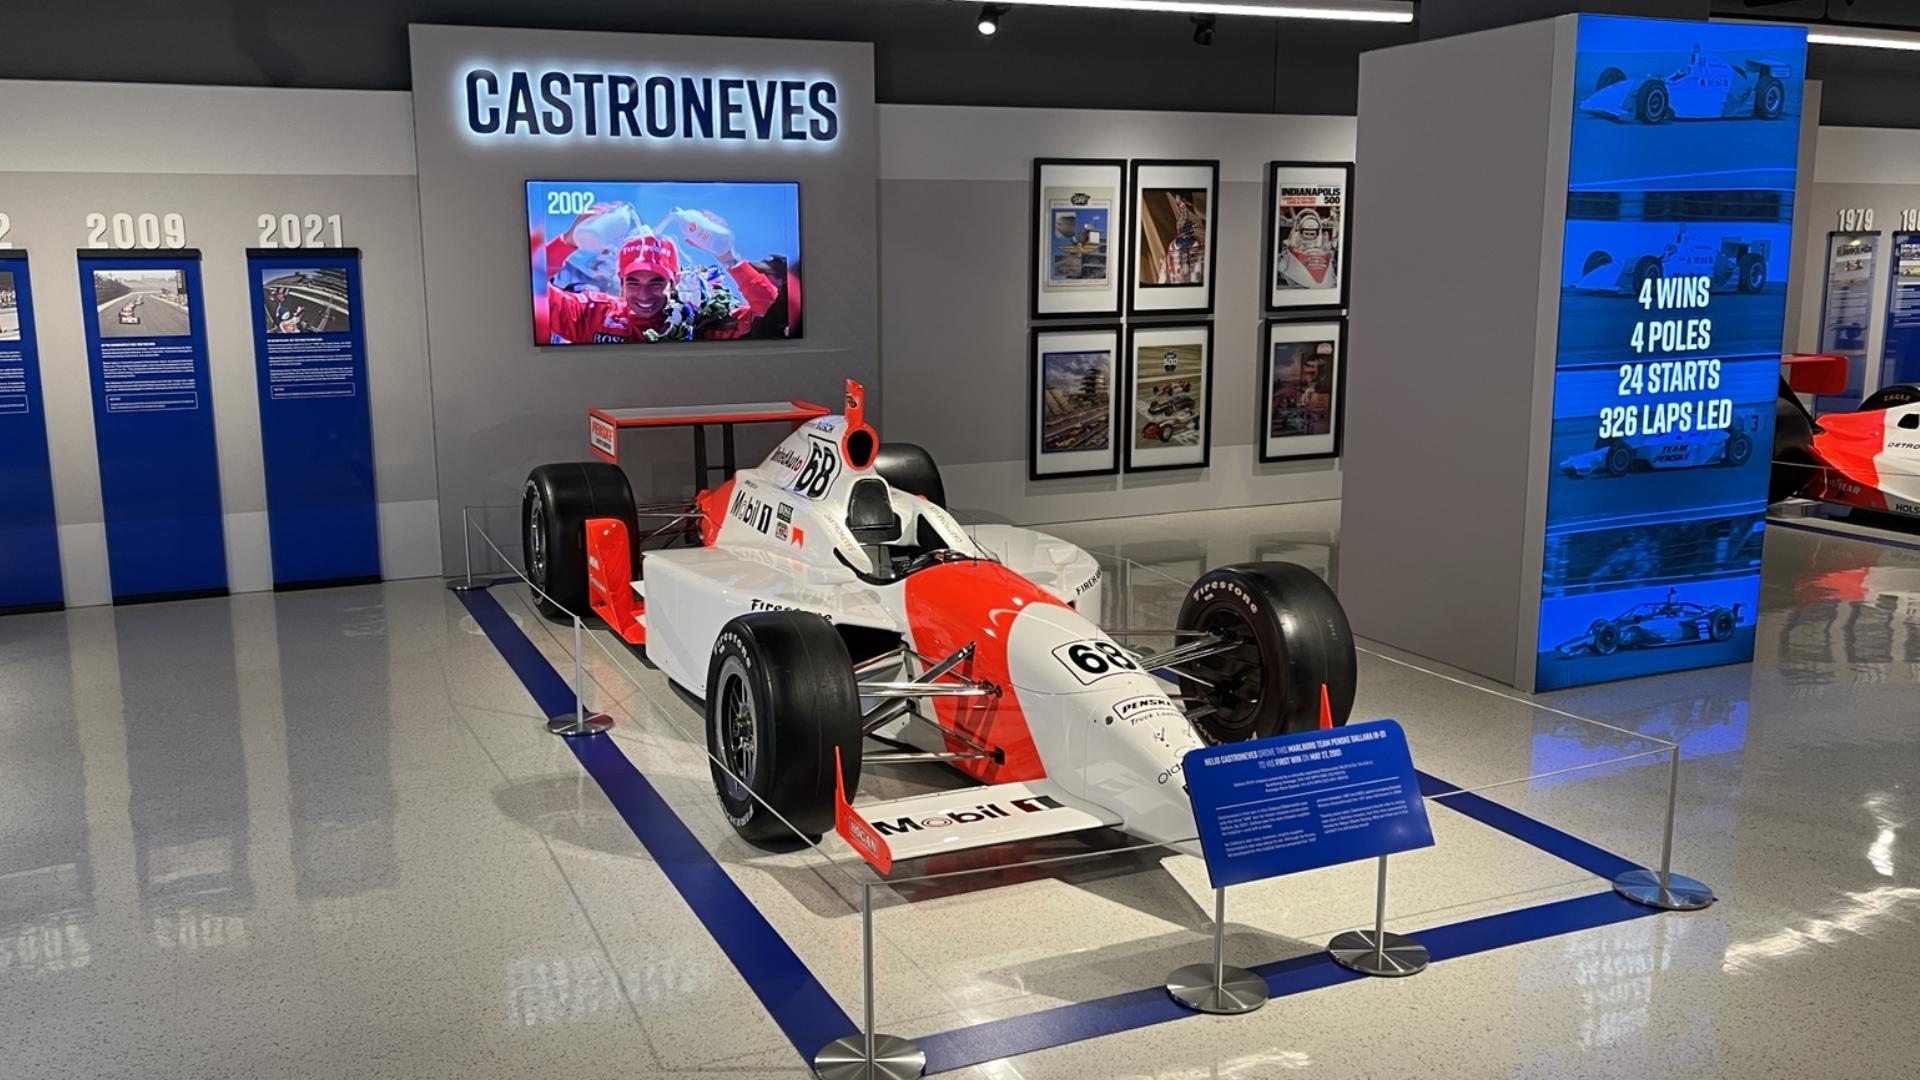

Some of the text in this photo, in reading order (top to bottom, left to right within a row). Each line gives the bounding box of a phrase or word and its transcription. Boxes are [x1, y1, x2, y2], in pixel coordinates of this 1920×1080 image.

[466, 69, 838, 142] CASTRONEVES
[547, 191, 595, 214] 2002
[1281, 187, 1340, 196] INDIANAPOLIS
[1324, 196, 1340, 204] 500
[86, 212, 186, 250] 2009
[257, 213, 344, 249] 2021
[1838, 208, 1874, 232] 1979
[1638, 276, 1711, 310] 4 WINS
[1630, 318, 1712, 353] 4 POLES
[1618, 359, 1721, 396] 24 STARTS
[1884, 394, 1912, 402] EAGLE
[1599, 398, 1733, 439] 326 LAPS LED
[1662, 444, 1690, 453] TEAM
[794, 442, 836, 498] 68
[730, 489, 762, 528] Mobil
[1193, 580, 1259, 615] Firestone
[714, 632, 752, 669] Firestone
[1068, 641, 1137, 675] 68
[1221, 751, 1258, 764] CASTRONEVES
[1287, 741, 1316, 753] MARLBORO
[1316, 739, 1331, 749] TEAM
[1331, 735, 1351, 747] PENSKE
[1350, 731, 1373, 743] DALLARA
[1275, 756, 1290, 767] FIRST
[1290, 754, 1302, 764] WIN
[1310, 751, 1321, 761] MAY
[871, 803, 1011, 836] Mobil
[850, 822, 878, 853] HOGAN
